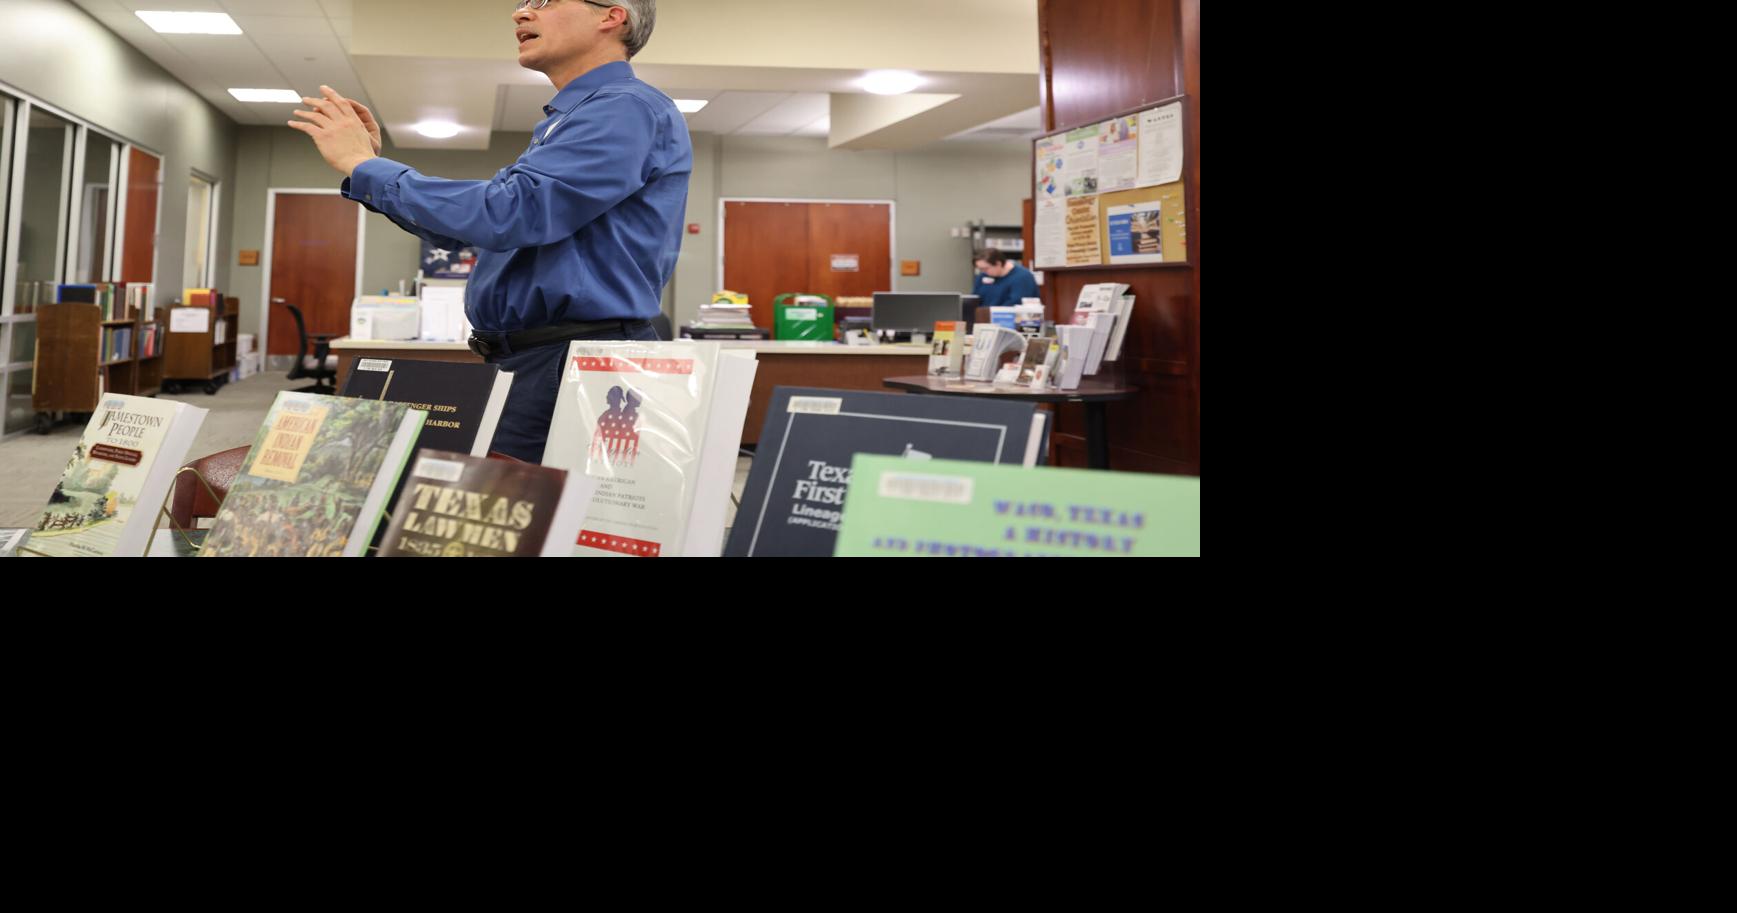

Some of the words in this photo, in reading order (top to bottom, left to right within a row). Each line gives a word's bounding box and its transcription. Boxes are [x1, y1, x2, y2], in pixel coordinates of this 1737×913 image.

[433, 404, 457, 413] SHIPS
[97, 410, 164, 430] JAMESTOWN
[276, 415, 319, 434] AMERICAN
[425, 419, 461, 429] HARBOR
[108, 423, 145, 438] PEOPLE
[272, 432, 305, 450] INDIAN
[792, 479, 847, 505] First
[414, 483, 535, 530] TEXAS
[1068, 504, 1145, 529] TEXAS
[402, 511, 522, 553] LAWMEN
[1004, 525, 1016, 541] A
[1025, 526, 1136, 553] HISTORY
